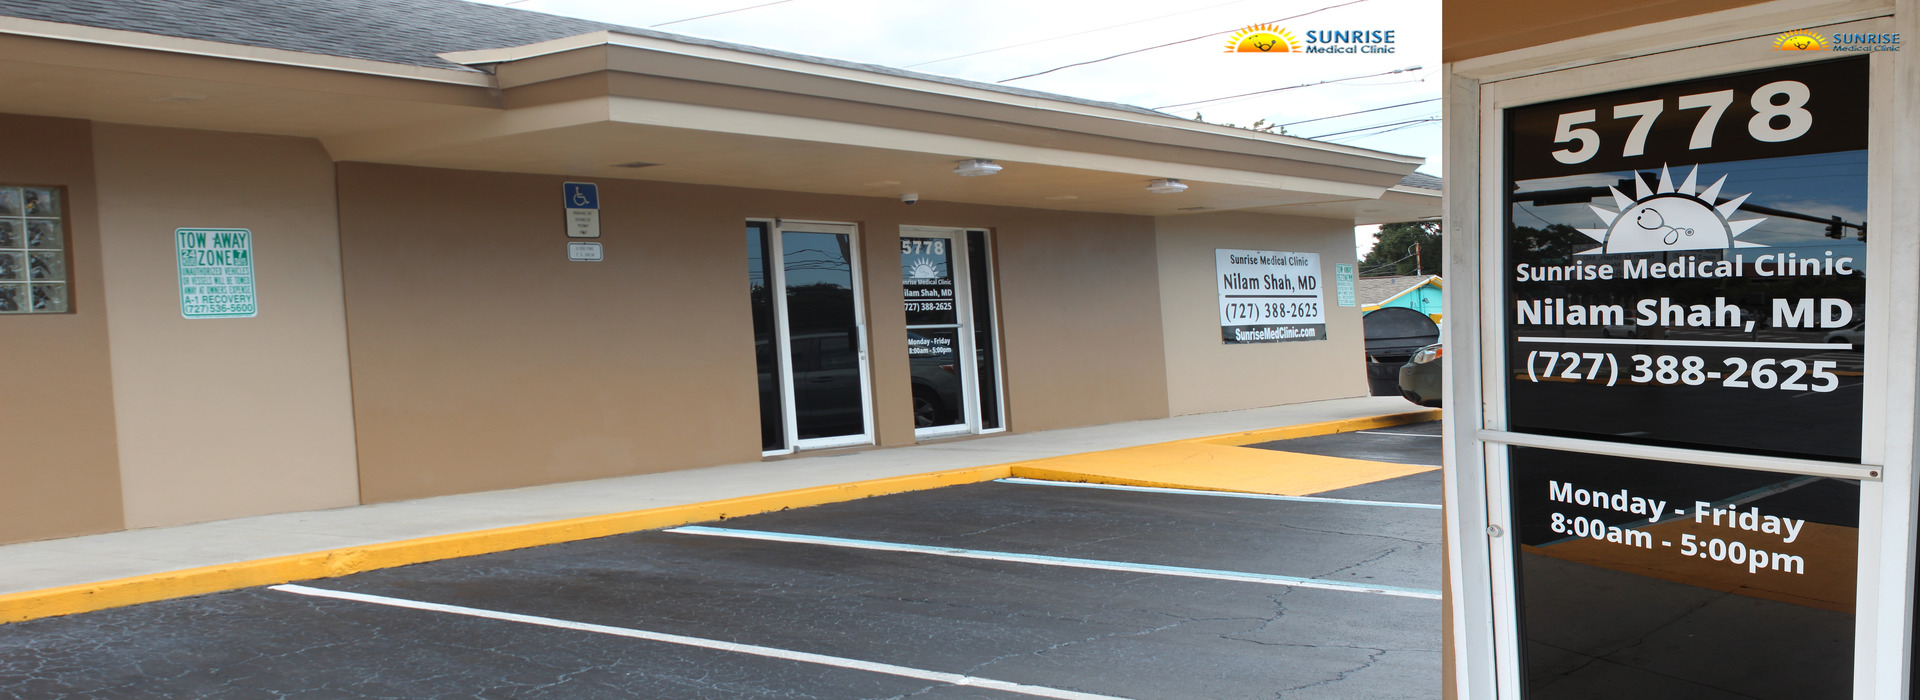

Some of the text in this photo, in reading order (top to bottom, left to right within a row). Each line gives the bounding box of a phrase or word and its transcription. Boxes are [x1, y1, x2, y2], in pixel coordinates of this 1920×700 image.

[1551, 80, 1813, 165] 5778
[180, 232, 246, 248] TOW AWAY
[902, 240, 944, 255] 5778
[198, 250, 232, 266] ZONE
[1230, 254, 1308, 266] Sunrise Medical Clinic
[1516, 250, 1853, 282] Sunrise Medical Clinic
[1223, 274, 1316, 292] Nilam Shah, MD
[202, 295, 252, 303] RECOVERY
[904, 289, 952, 298] ilam Shah, MD
[904, 302, 952, 312] 727) 388-2625
[1225, 303, 1317, 322] (727) 388-2625
[1516, 296, 1854, 333] Nilam Shah, MD
[908, 338, 930, 346] Monday
[934, 337, 950, 346] Friday
[1235, 327, 1315, 341] SunriseMedClinic.com
[932, 346, 951, 354] 5:00pm
[1527, 350, 1839, 393] (727) 388-2625
[1549, 480, 1667, 523] Monday
[1695, 500, 1805, 544] Friday
[1550, 512, 1653, 549] 8:00am
[1680, 534, 1805, 575] 5:00pm
